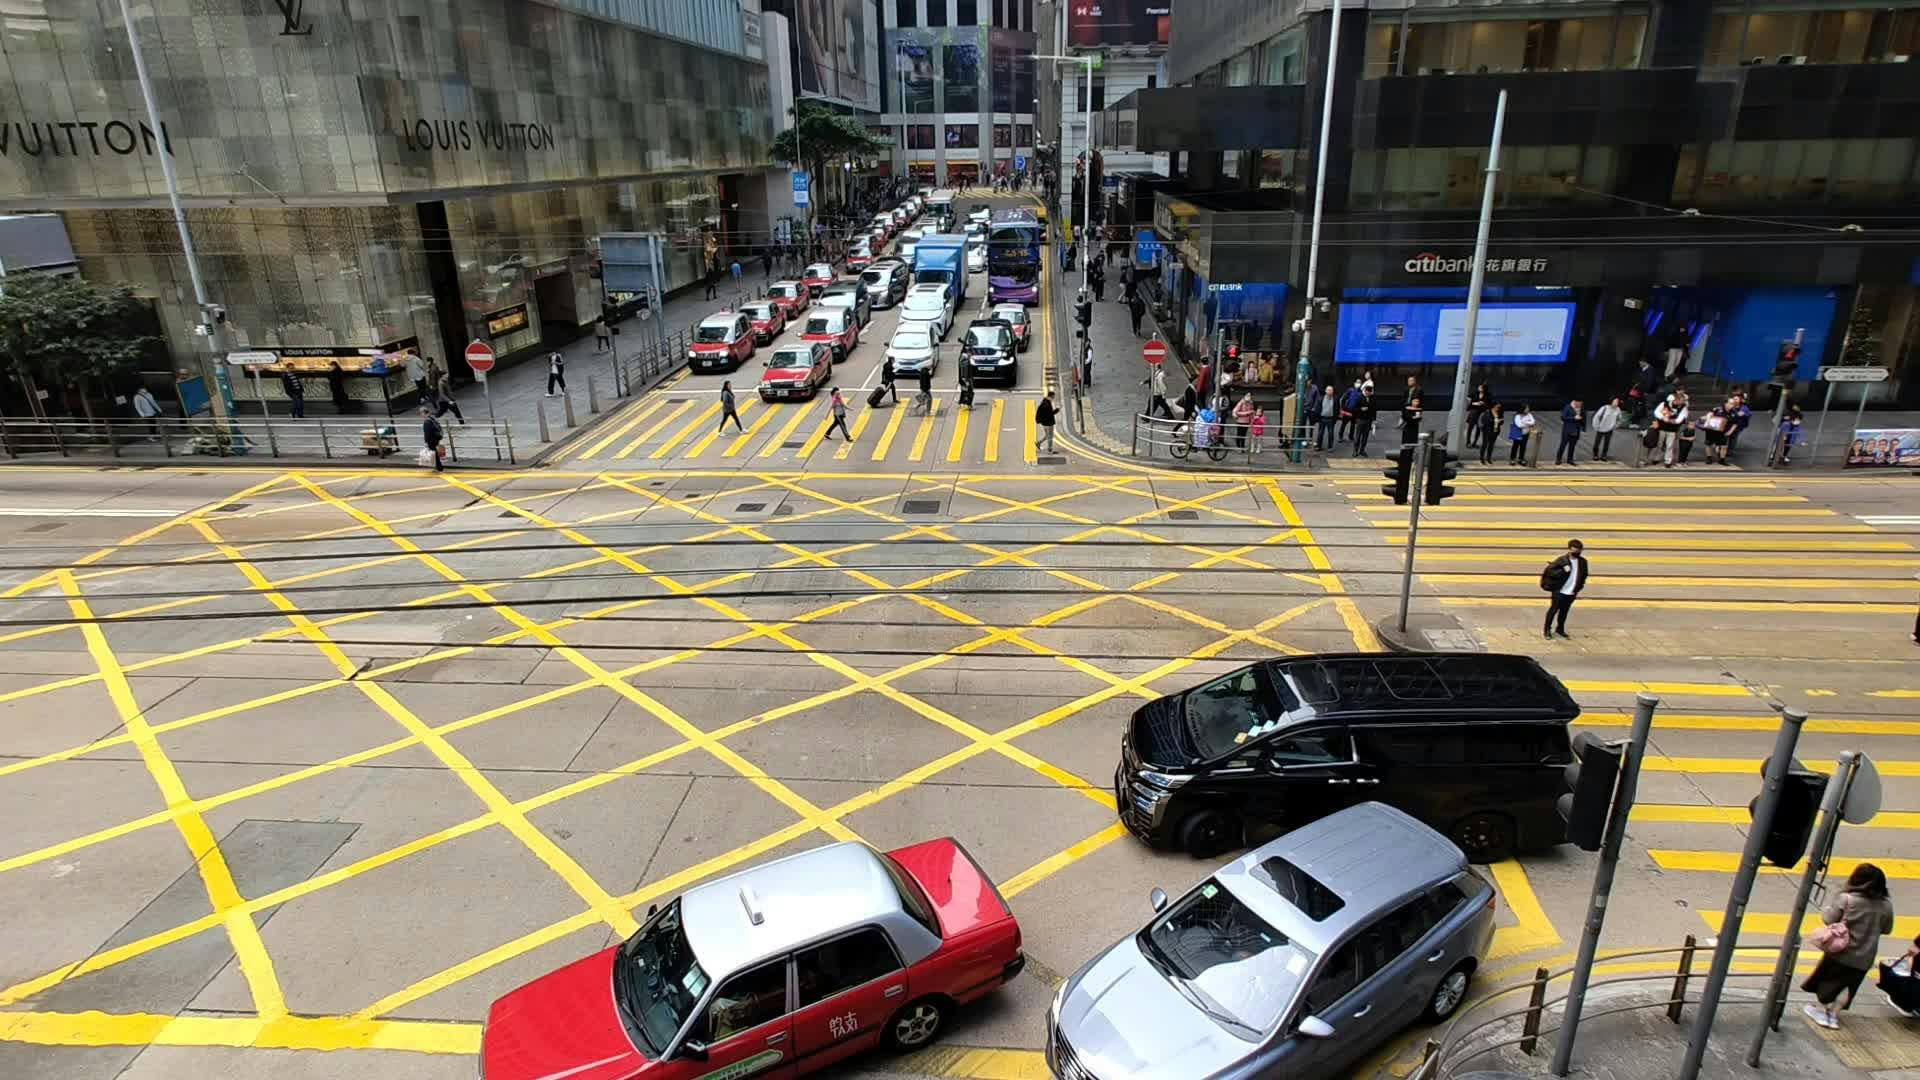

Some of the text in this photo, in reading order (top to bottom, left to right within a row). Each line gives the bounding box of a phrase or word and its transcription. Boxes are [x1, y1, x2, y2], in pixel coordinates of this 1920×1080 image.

[402, 119, 555, 152] LOUIS VUITTON
[1486, 258, 1548, 272] 花旗銀行
[829, 1011, 857, 1030] 的士
[832, 1018, 859, 1039] TAXI
